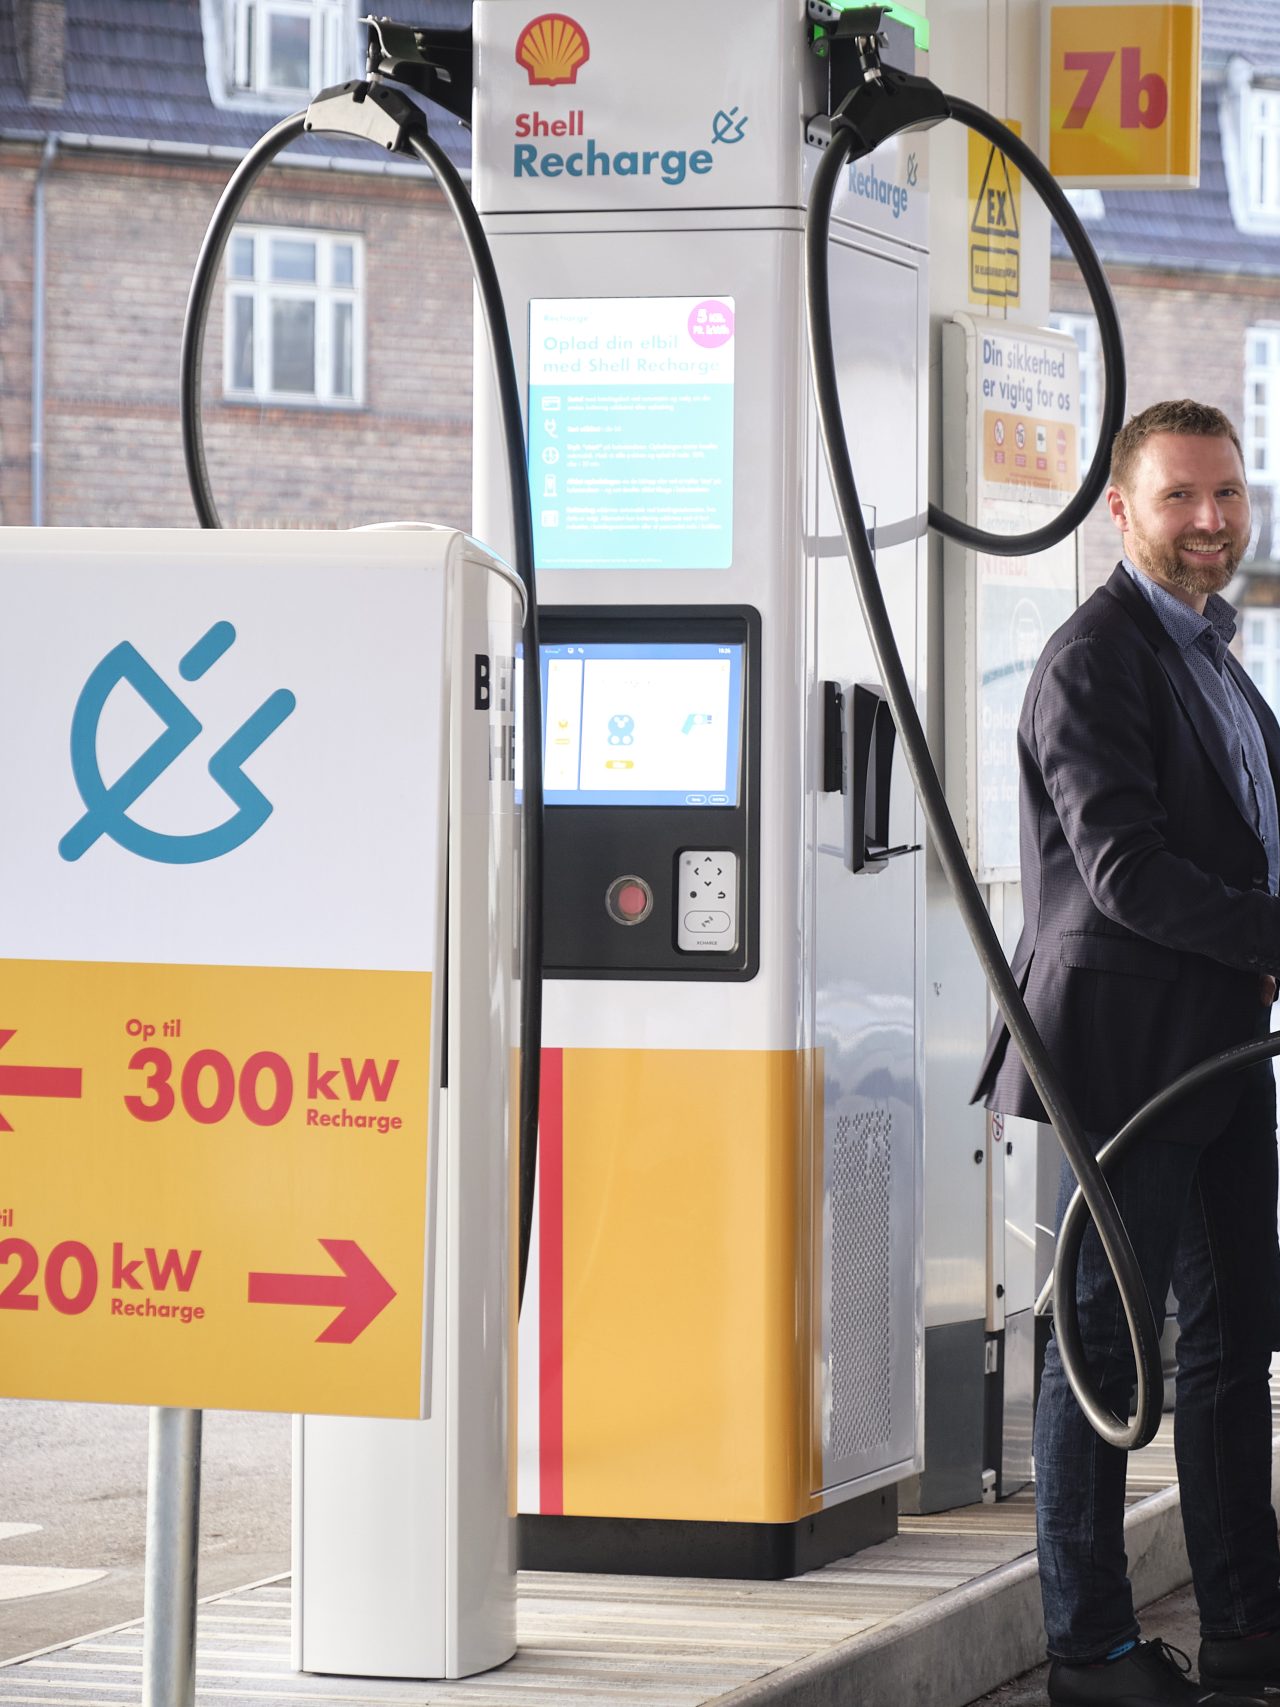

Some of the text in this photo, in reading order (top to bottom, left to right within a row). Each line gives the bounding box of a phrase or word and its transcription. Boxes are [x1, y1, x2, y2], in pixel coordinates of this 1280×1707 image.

[1061, 46, 1168, 129] 7b
[515, 110, 584, 138] Shell
[513, 139, 714, 186] Recharge
[848, 160, 908, 218] Recharge
[987, 188, 1007, 226] EX
[543, 334, 680, 355] Oplad din elbil
[983, 338, 1065, 379] Din sikkerhed
[543, 357, 720, 375] med Shell Recharge
[982, 373, 1071, 412] er vigtig for os
[125, 1018, 182, 1042] Op til
[123, 1046, 401, 1127] 300 kW
[305, 1108, 403, 1134] Recharge
[0, 1237, 203, 1316] 20 kW
[110, 1298, 206, 1324] Recharge
